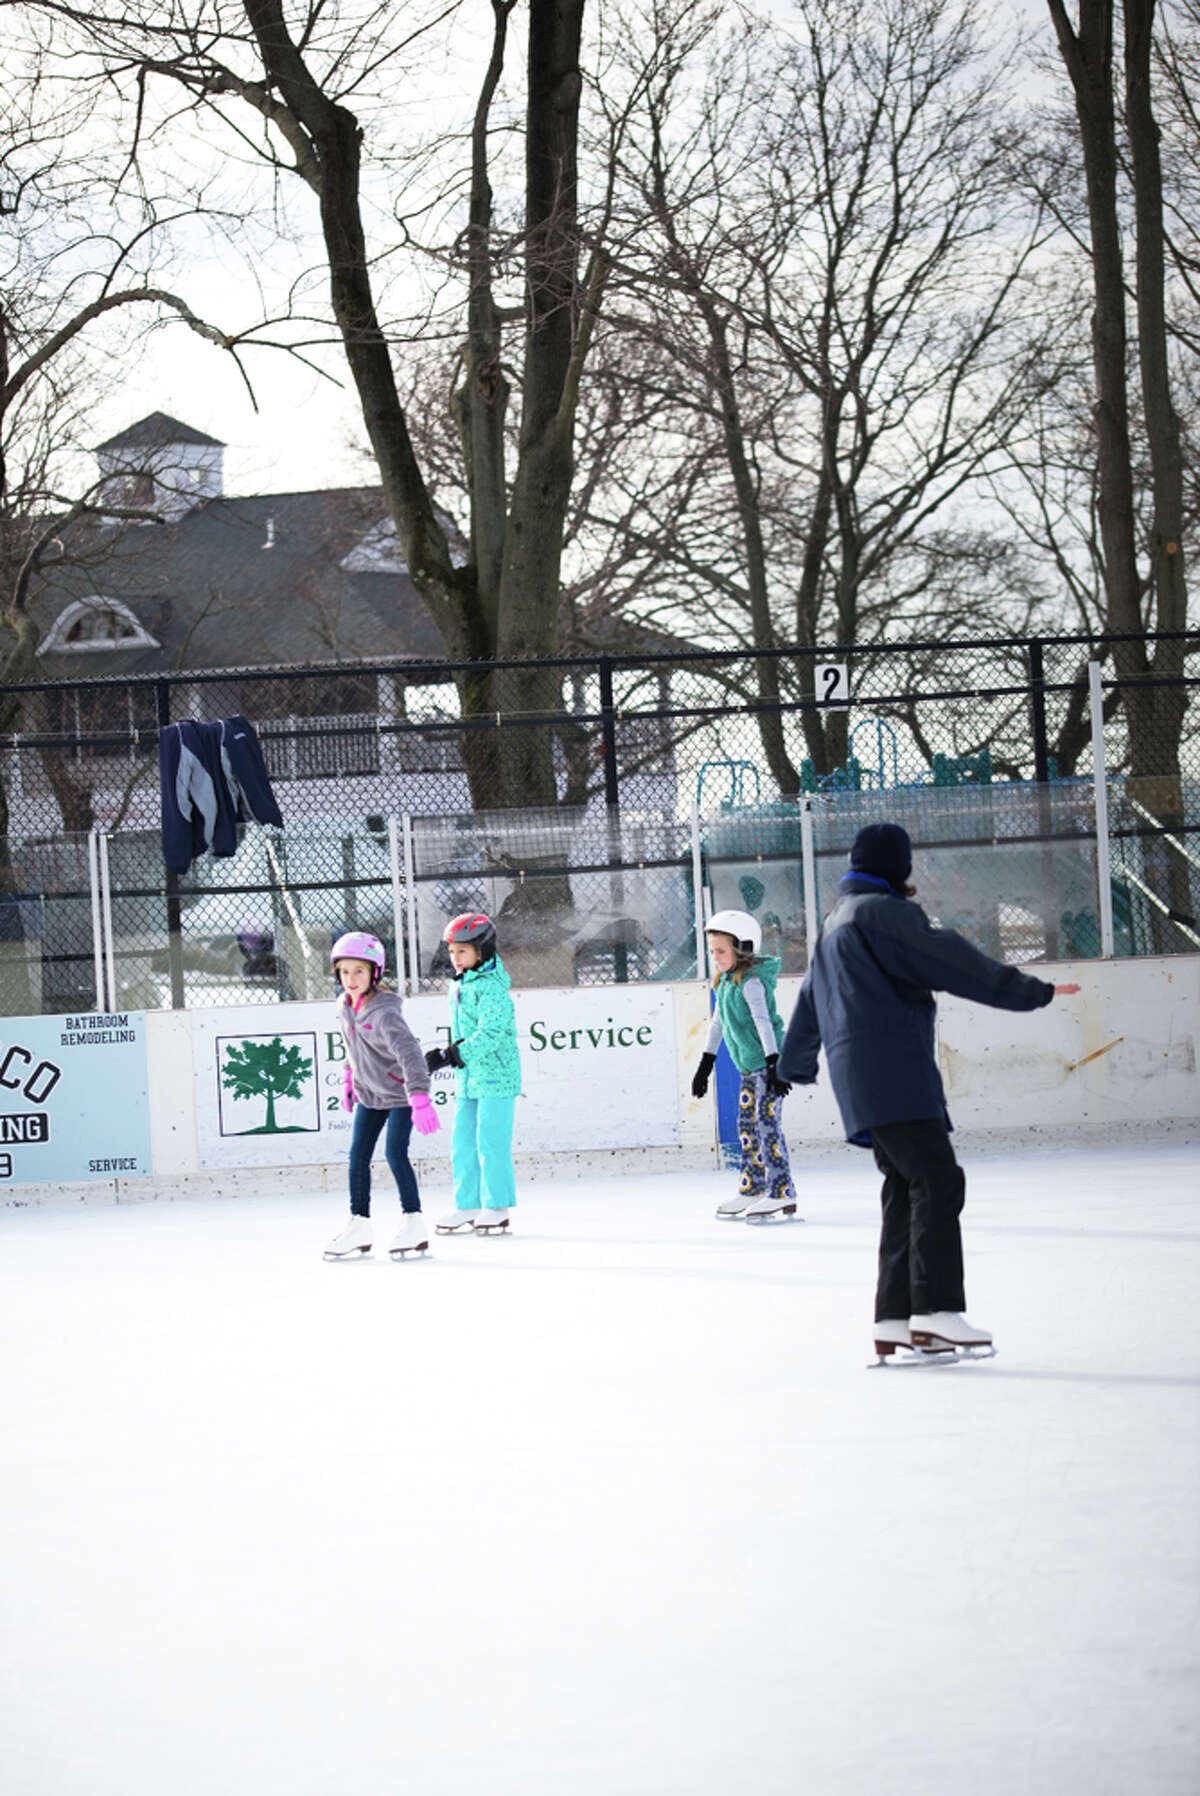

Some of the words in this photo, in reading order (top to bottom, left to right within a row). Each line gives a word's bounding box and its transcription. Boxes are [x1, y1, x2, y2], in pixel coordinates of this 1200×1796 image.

[823, 668, 840, 700] 2
[66, 1015, 129, 1030] BATHROOM
[61, 1030, 136, 1046] REMODELING
[530, 1017, 653, 1052] Service
[89, 1158, 137, 1172] SERVICE
